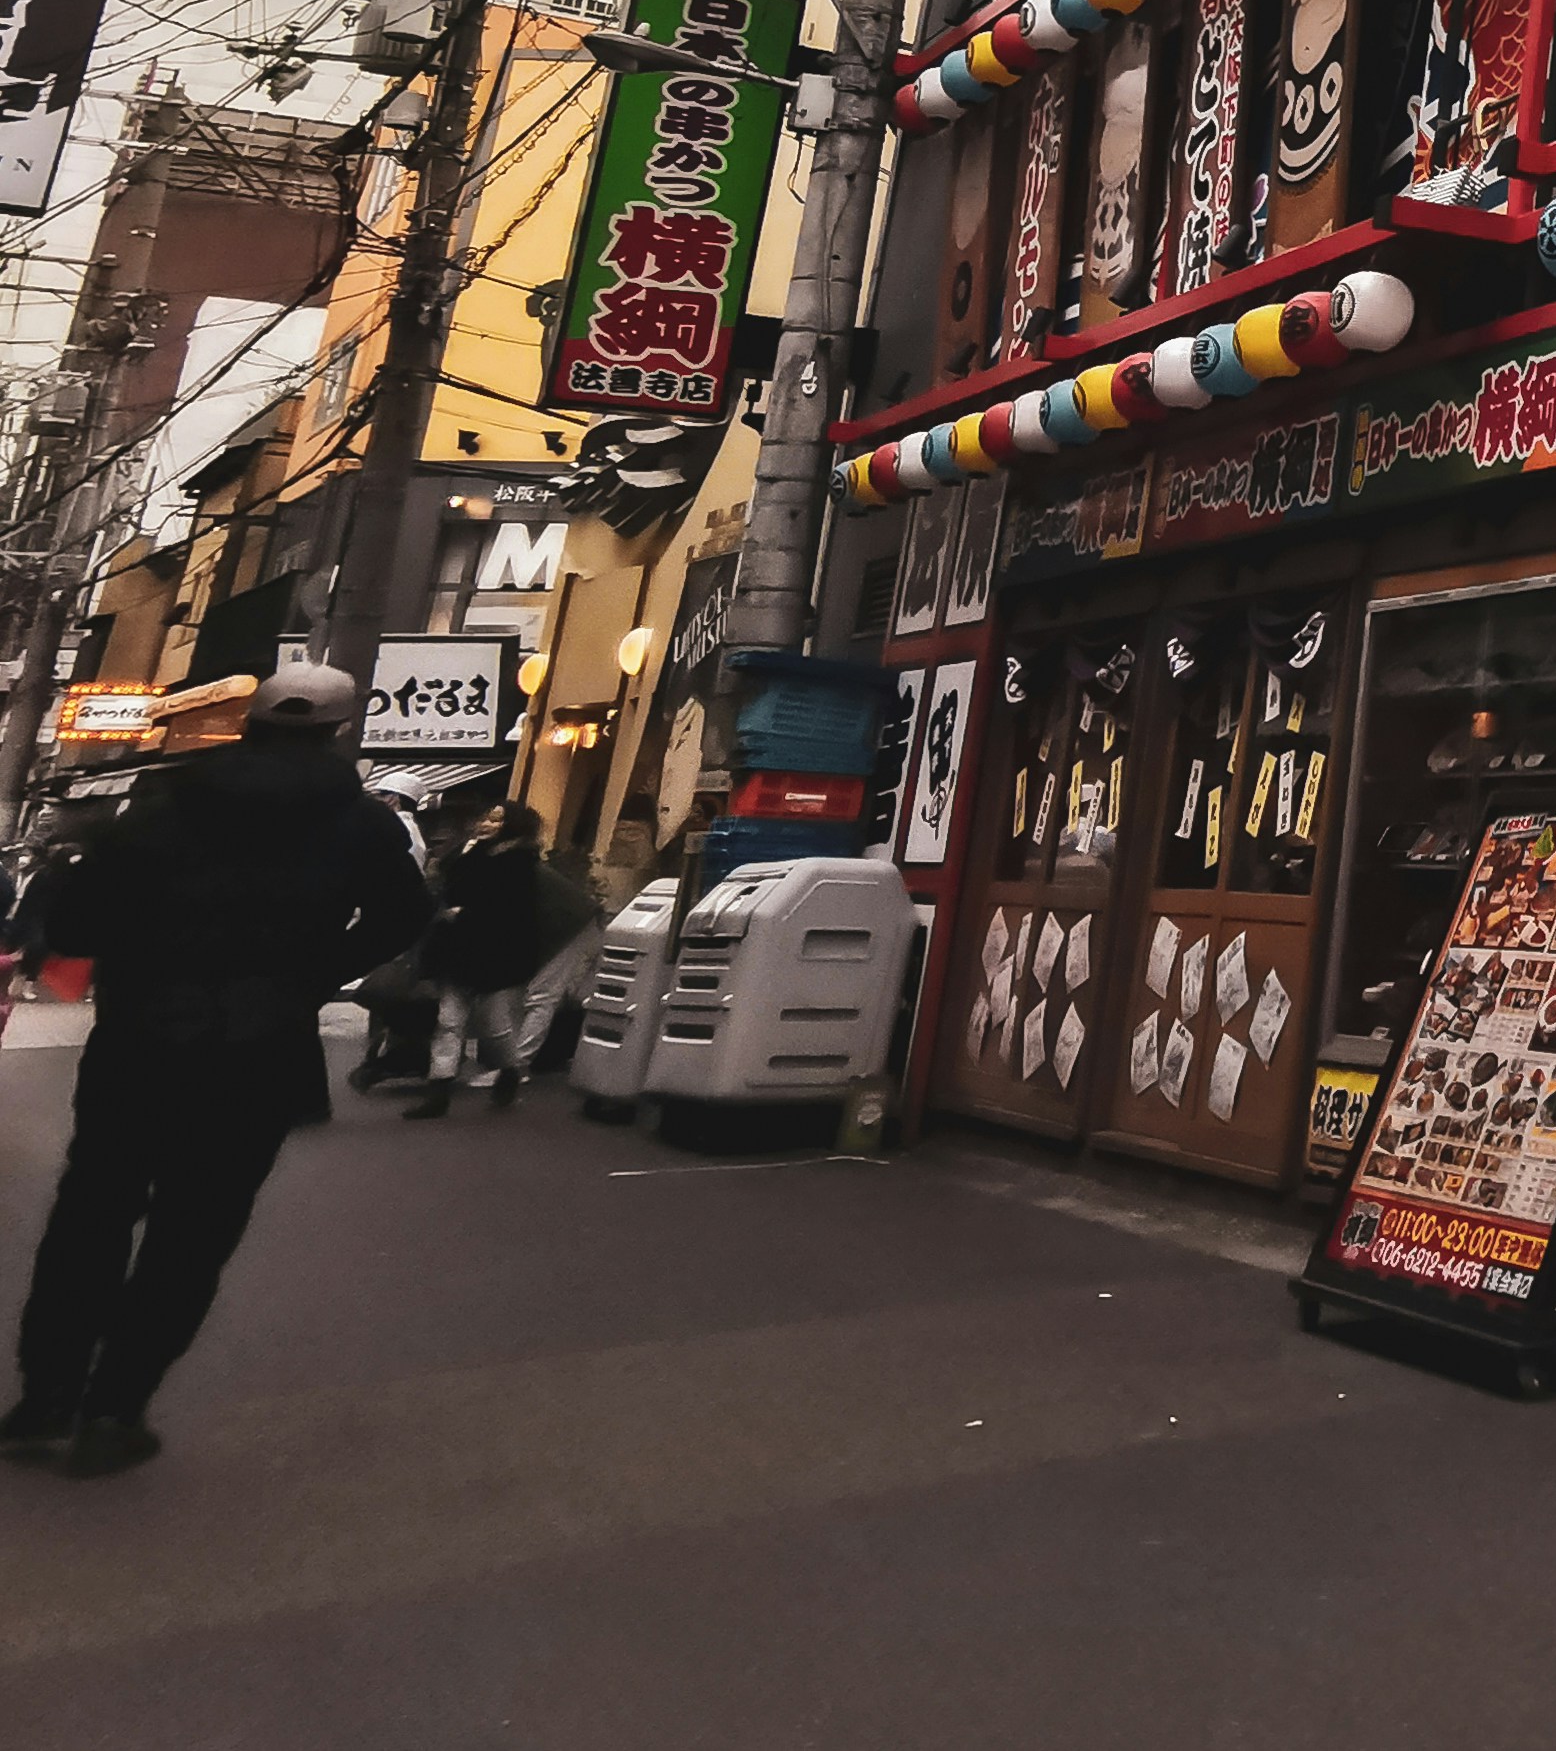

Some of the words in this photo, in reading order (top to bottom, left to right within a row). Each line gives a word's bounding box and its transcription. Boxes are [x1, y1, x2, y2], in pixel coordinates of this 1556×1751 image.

[589, 201, 738, 369] 横綱
[568, 360, 717, 405] 法善寺店
[1166, 459, 1250, 523] 日本一の串かつ
[1246, 418, 1318, 519] 横綱
[1366, 401, 1477, 476] 日本一の串かつ
[1382, 1238, 1484, 1291] 06-6212-4455
